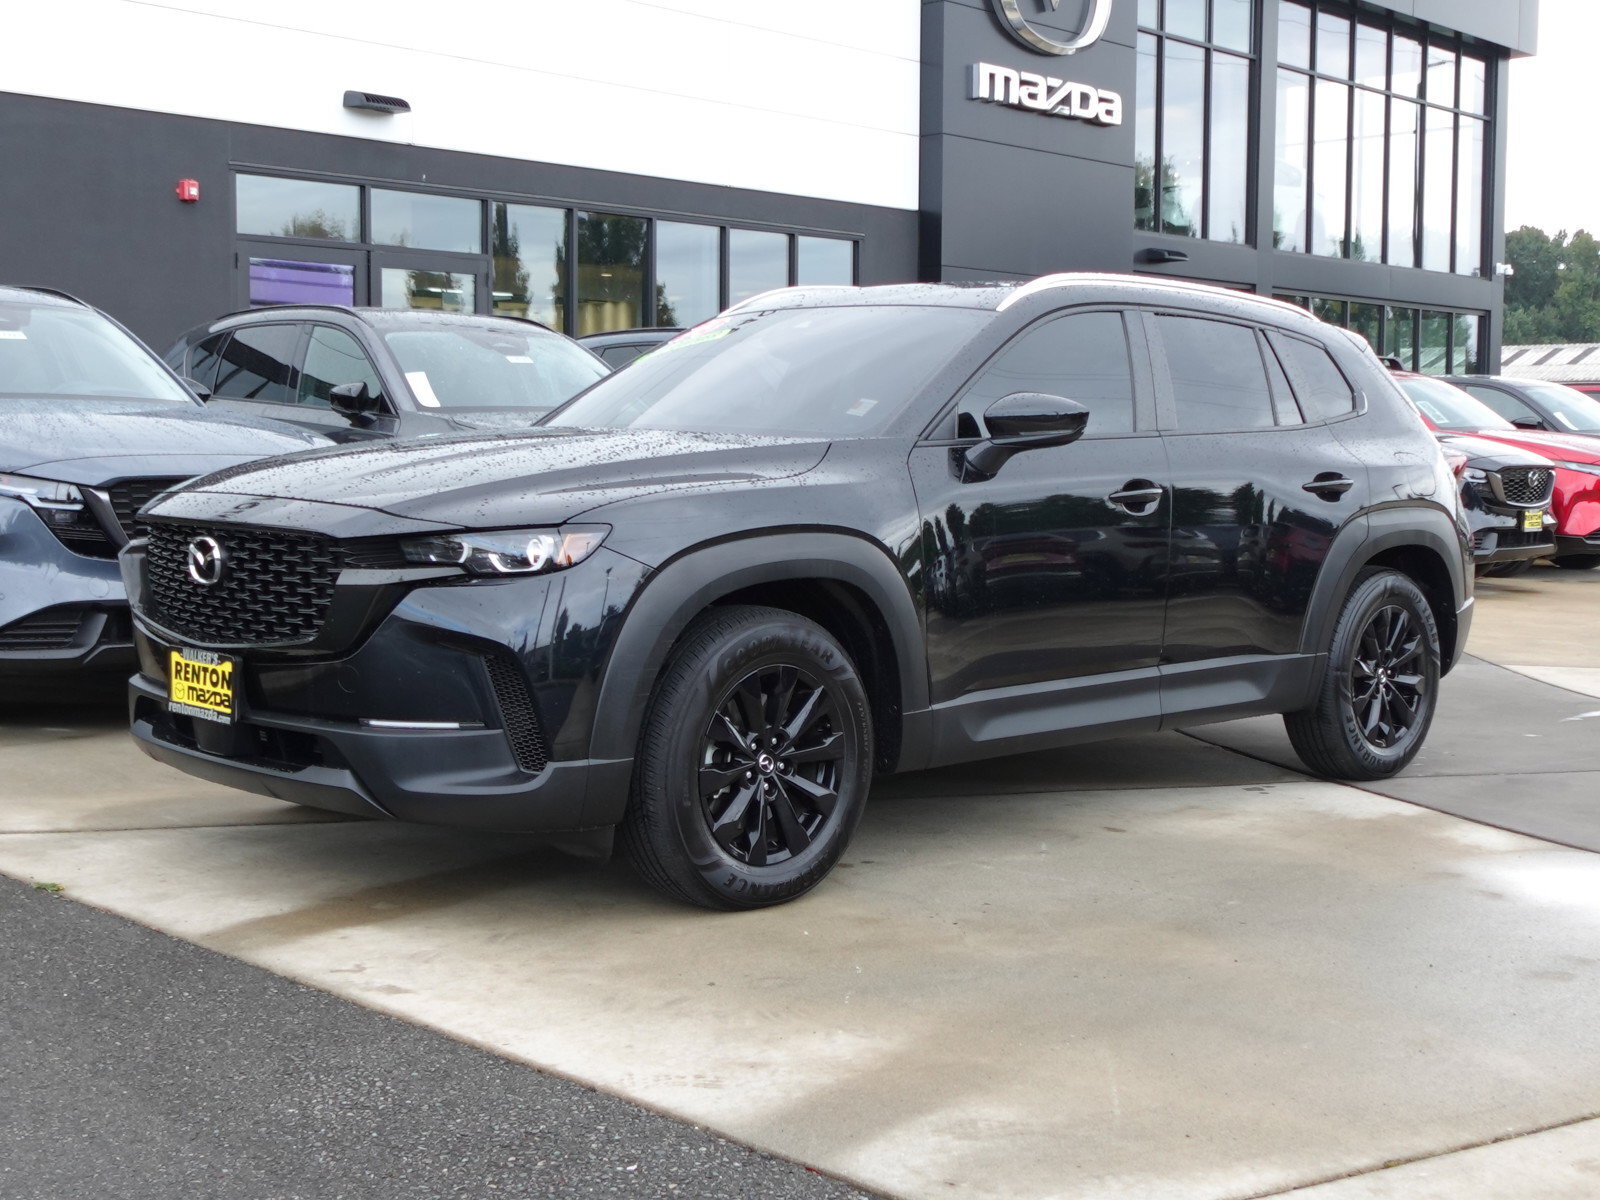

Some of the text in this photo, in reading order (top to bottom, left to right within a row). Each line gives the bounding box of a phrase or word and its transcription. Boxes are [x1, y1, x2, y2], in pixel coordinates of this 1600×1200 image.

[974, 62, 1122, 125] mazda
[183, 648, 219, 665] WALKER'S
[174, 661, 232, 691] RENTON
[187, 685, 232, 709] mazda
[168, 702, 231, 724] rentonmazda.com
